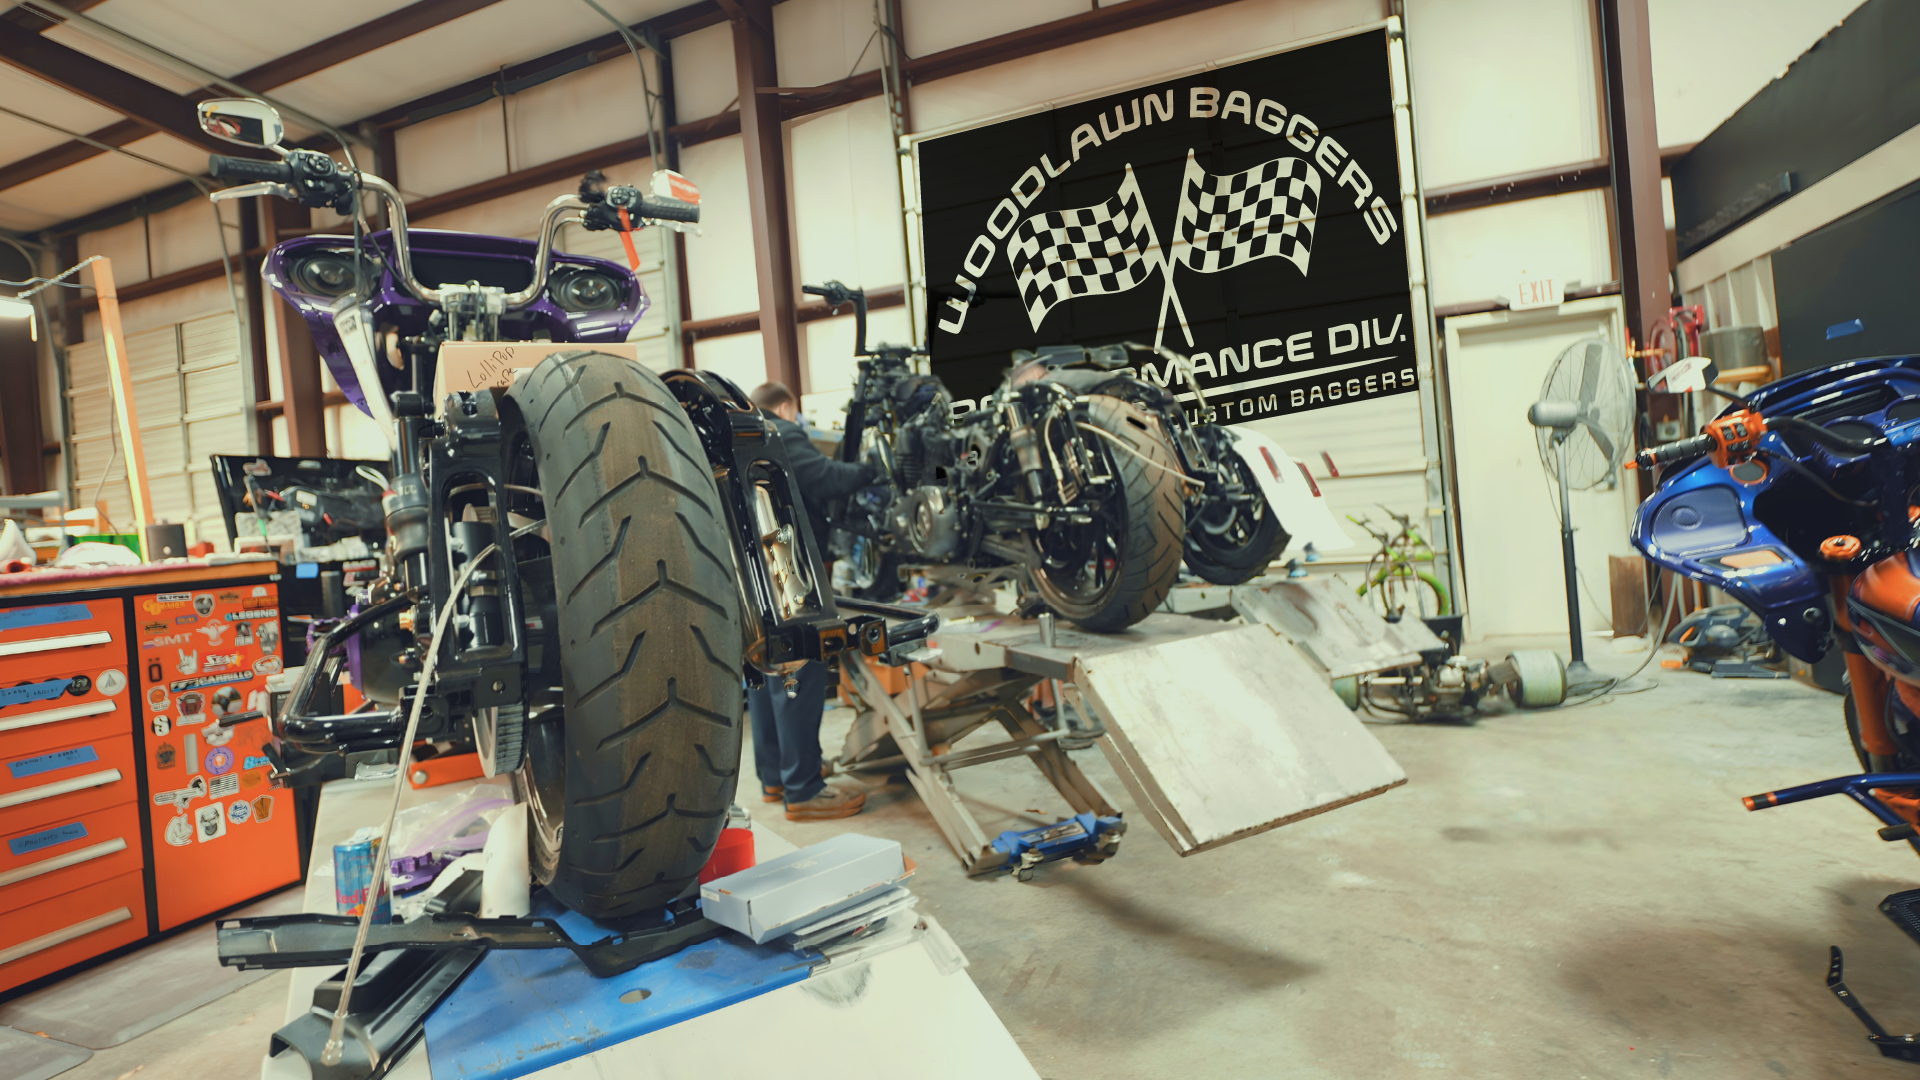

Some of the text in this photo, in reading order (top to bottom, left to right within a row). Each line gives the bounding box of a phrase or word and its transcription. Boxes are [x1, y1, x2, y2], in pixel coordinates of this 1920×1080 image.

[938, 87, 1398, 334] WOODLAWN BAGGERS
[1519, 279, 1553, 305] EXIT
[948, 314, 1406, 428] PMANCE DIV.
[1174, 368, 1415, 433] USTOM BAGGERS
